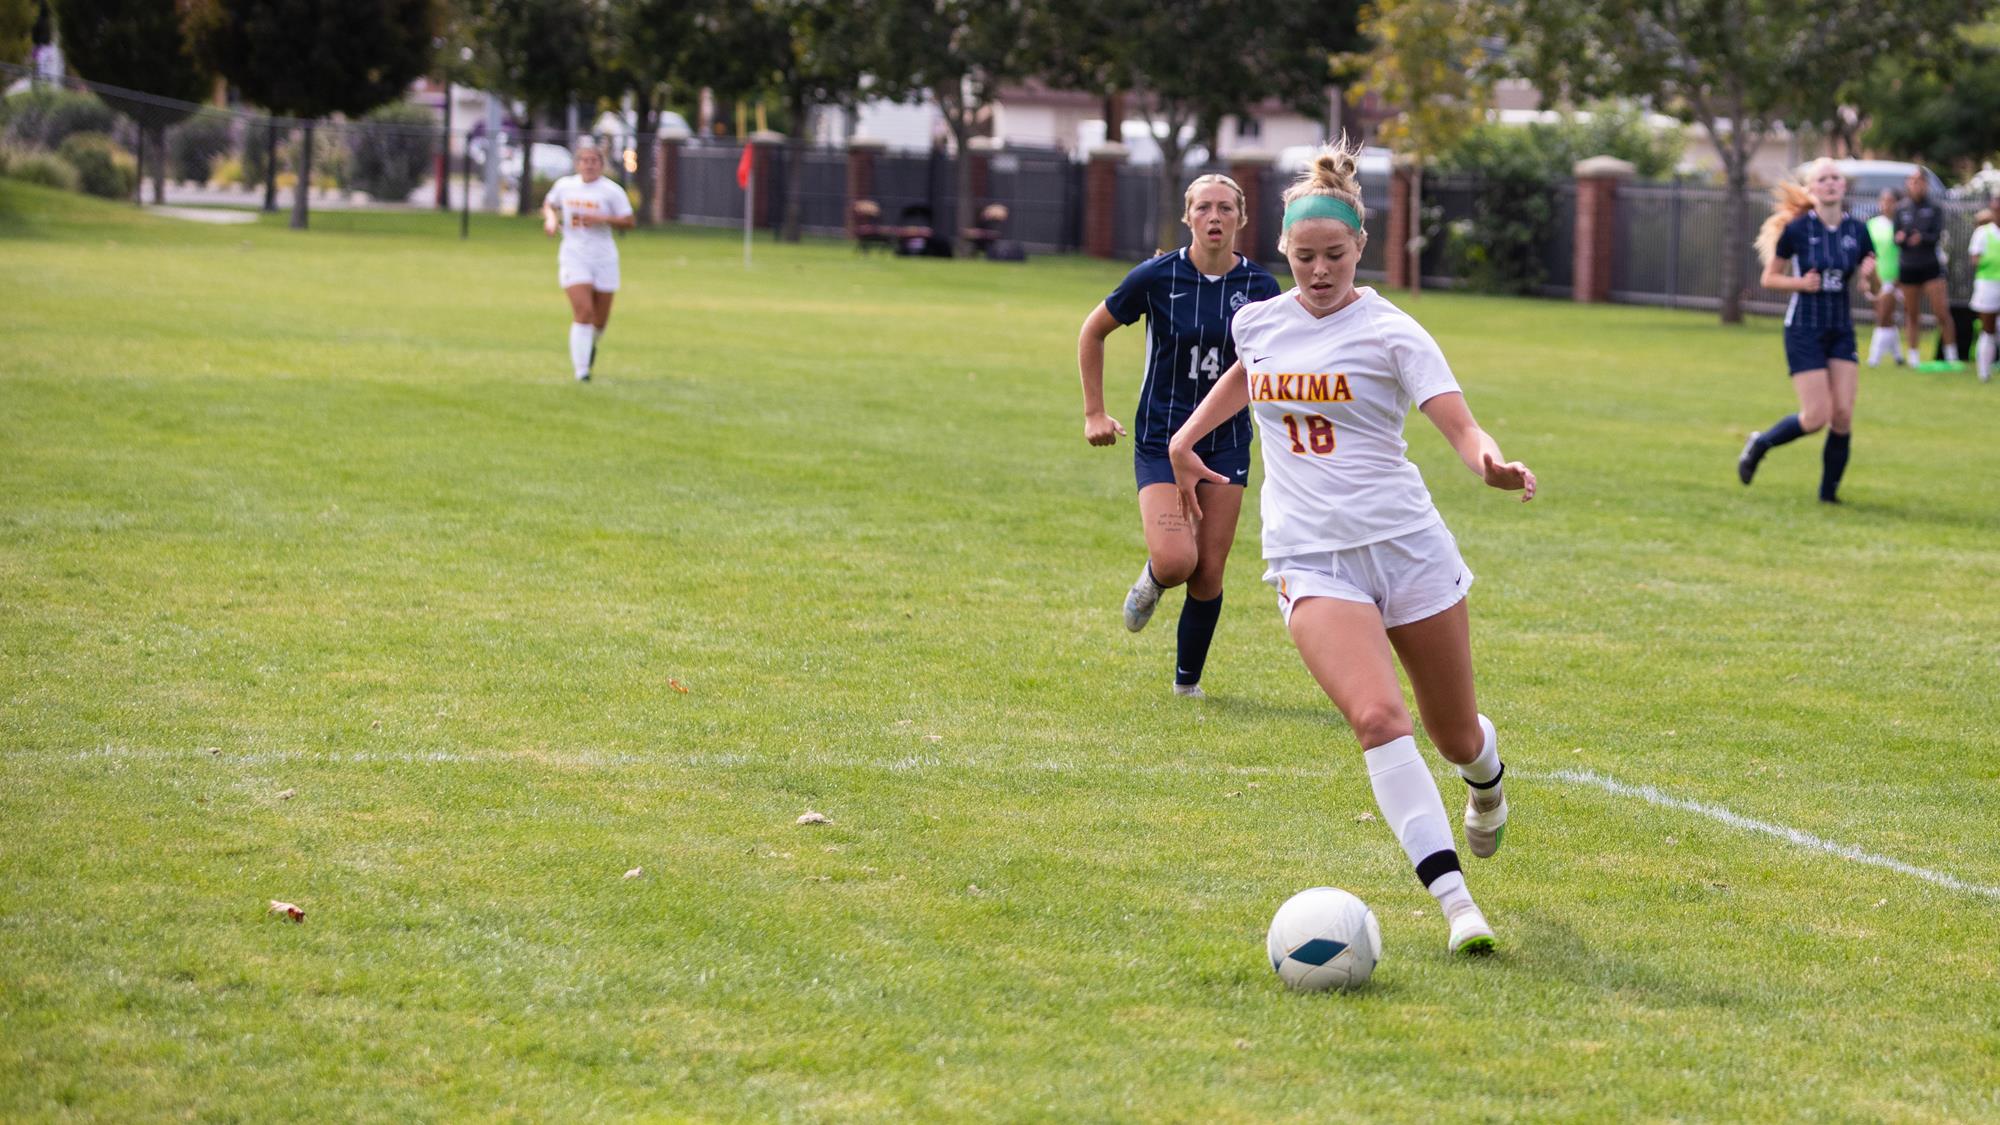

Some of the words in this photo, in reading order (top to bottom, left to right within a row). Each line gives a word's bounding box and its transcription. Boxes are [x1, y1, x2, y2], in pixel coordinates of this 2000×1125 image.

[1188, 345, 1220, 380] 14
[1250, 373, 1354, 402] YAKIMA
[1282, 413, 1336, 455] 18
